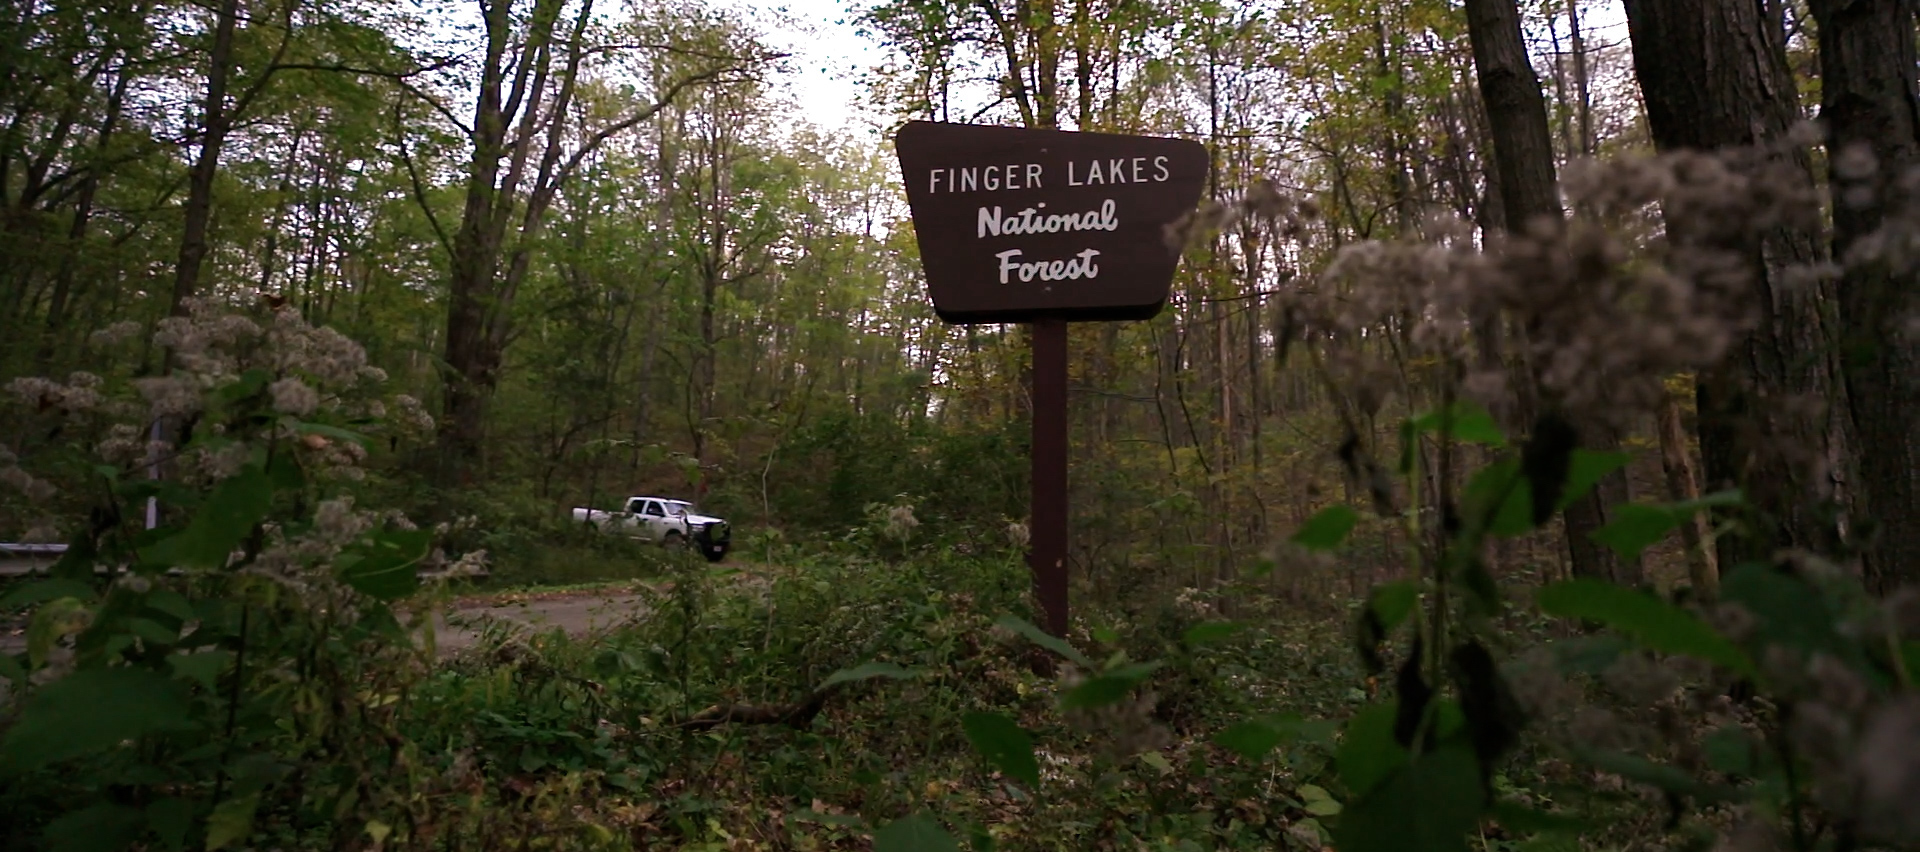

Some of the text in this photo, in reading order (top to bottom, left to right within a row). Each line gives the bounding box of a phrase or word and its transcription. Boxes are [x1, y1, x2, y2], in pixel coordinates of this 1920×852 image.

[929, 155, 1169, 193] FINGER LAKES
[977, 199, 1119, 239] National
[995, 248, 1101, 284] Forest
